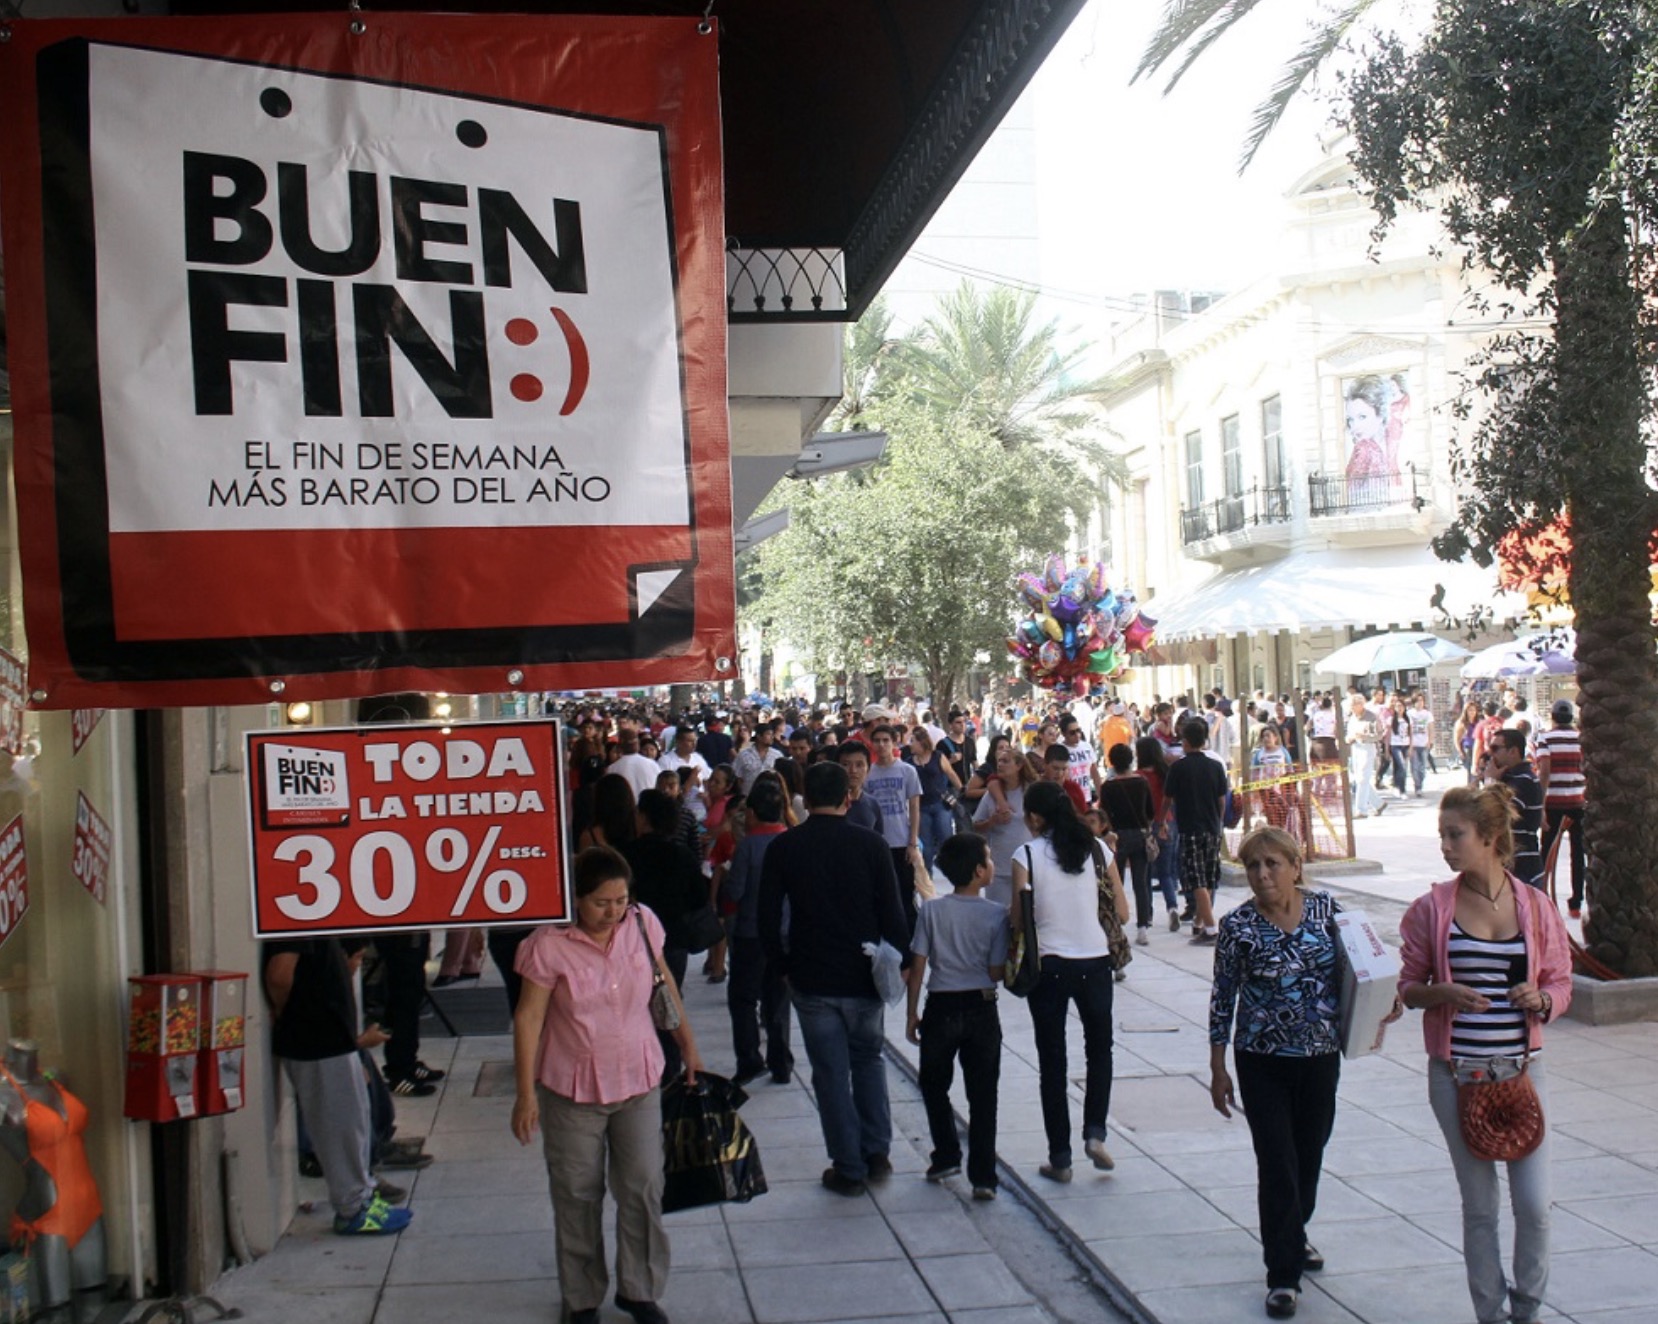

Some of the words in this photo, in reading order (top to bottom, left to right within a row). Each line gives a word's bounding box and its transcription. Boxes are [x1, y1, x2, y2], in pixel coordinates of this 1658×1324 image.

[183, 150, 588, 294] BUEN
[245, 441, 280, 469] EL
[292, 442, 344, 470] FIN
[357, 443, 402, 470] DE
[412, 443, 566, 470] SEMANA
[208, 471, 287, 507] MÁS
[300, 478, 440, 506] BARATO
[453, 477, 515, 504] DEL
[526, 472, 611, 503] AÑO
[277, 758, 335, 776] BUEN
[364, 738, 535, 782] TODA
[359, 796, 407, 820] LA
[413, 790, 545, 817] TIENDA
[273, 825, 528, 922] 30%
[500, 846, 547, 859] DESC.
[0, 867, 26, 935] 0%
